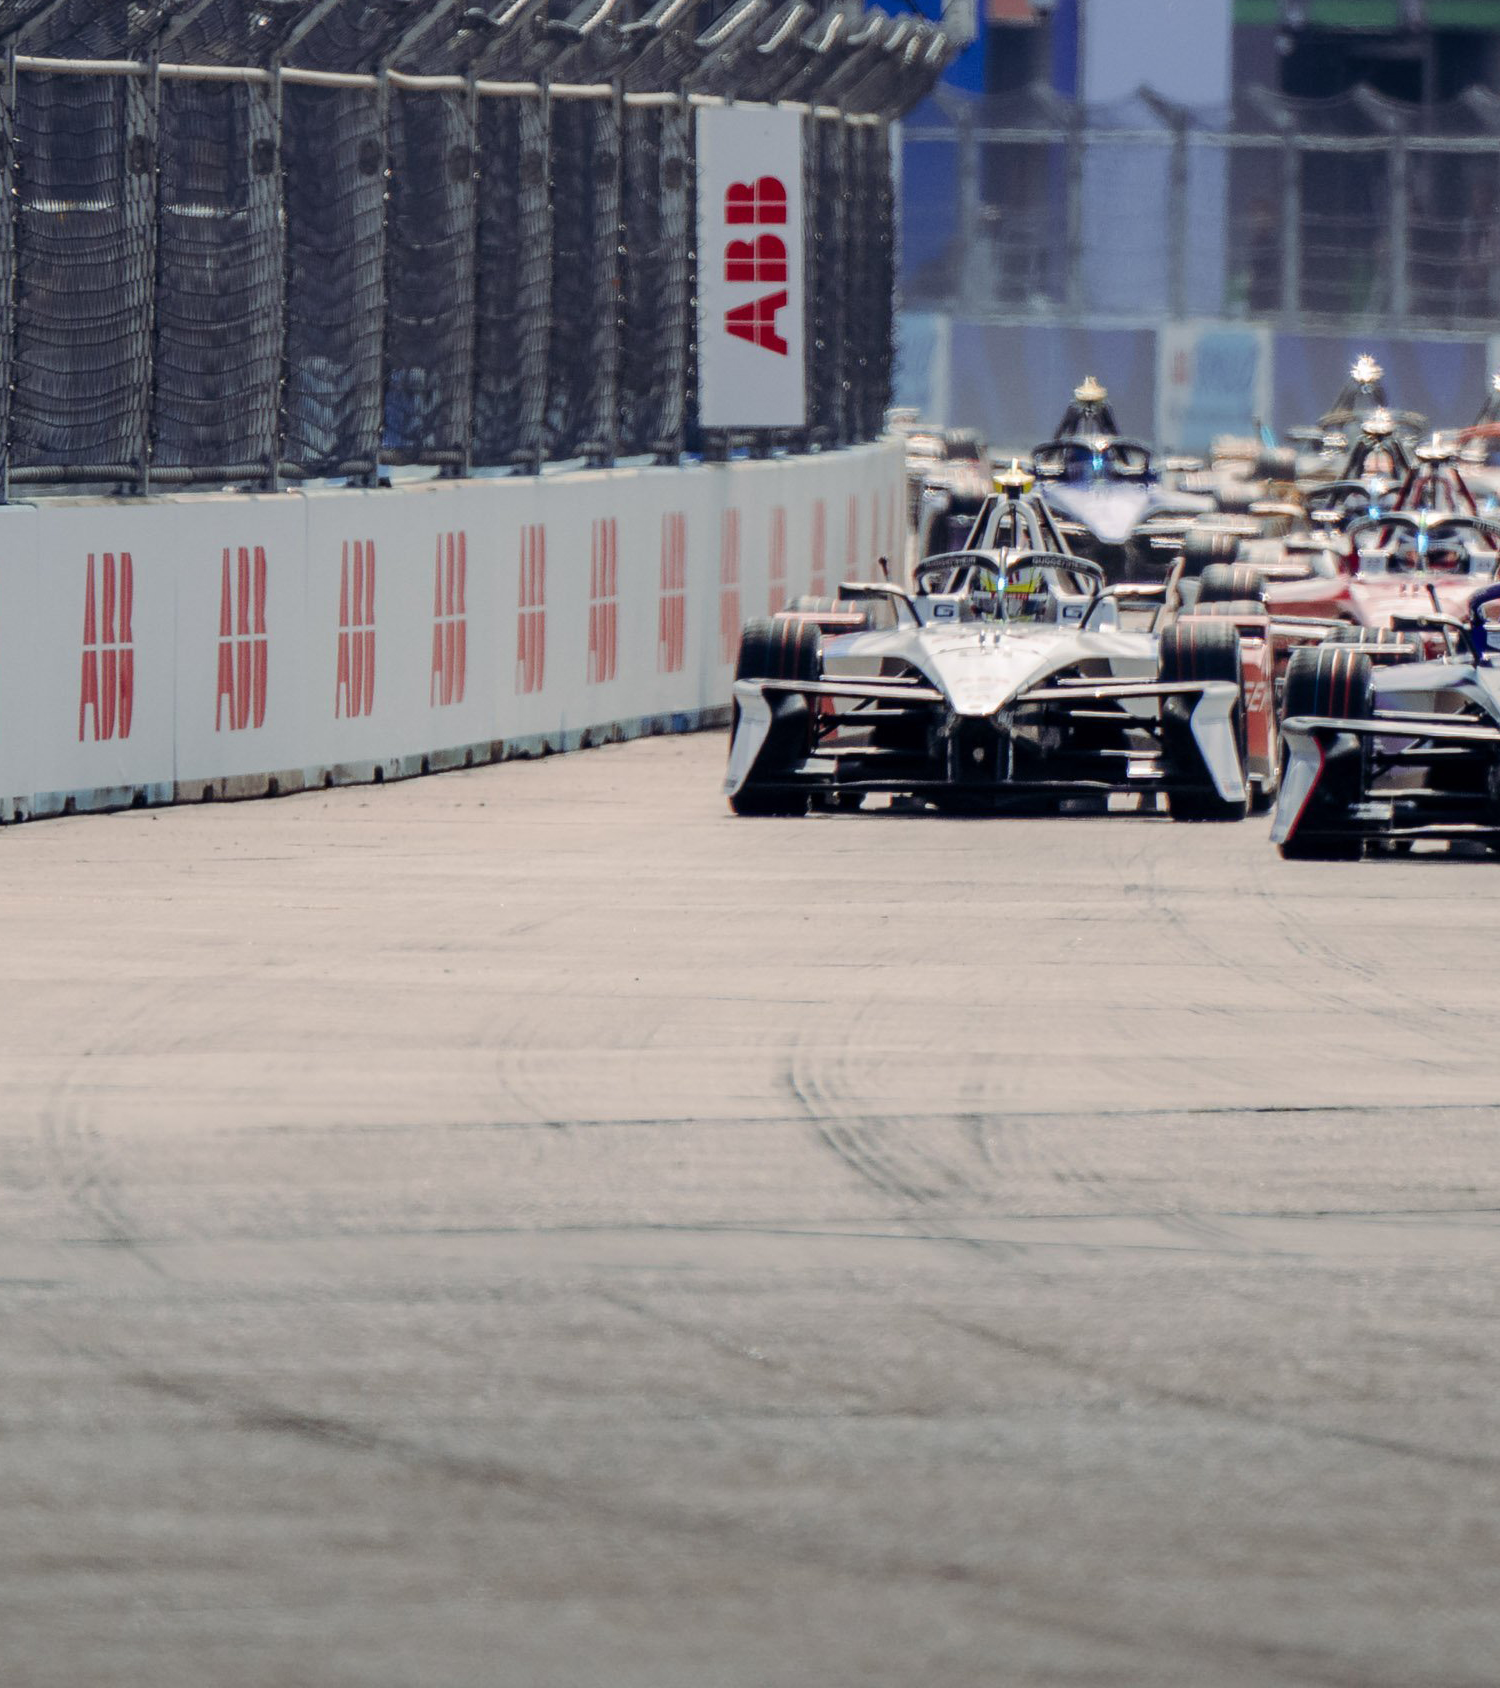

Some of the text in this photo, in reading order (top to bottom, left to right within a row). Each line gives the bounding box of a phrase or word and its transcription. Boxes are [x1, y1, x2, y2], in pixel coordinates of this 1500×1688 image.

[724, 175, 789, 357] ABB
[79, 552, 134, 742] ABB
[215, 546, 268, 733] ABB
[334, 539, 376, 720] ABB
[430, 530, 468, 709] ABB
[515, 524, 547, 695] ABB
